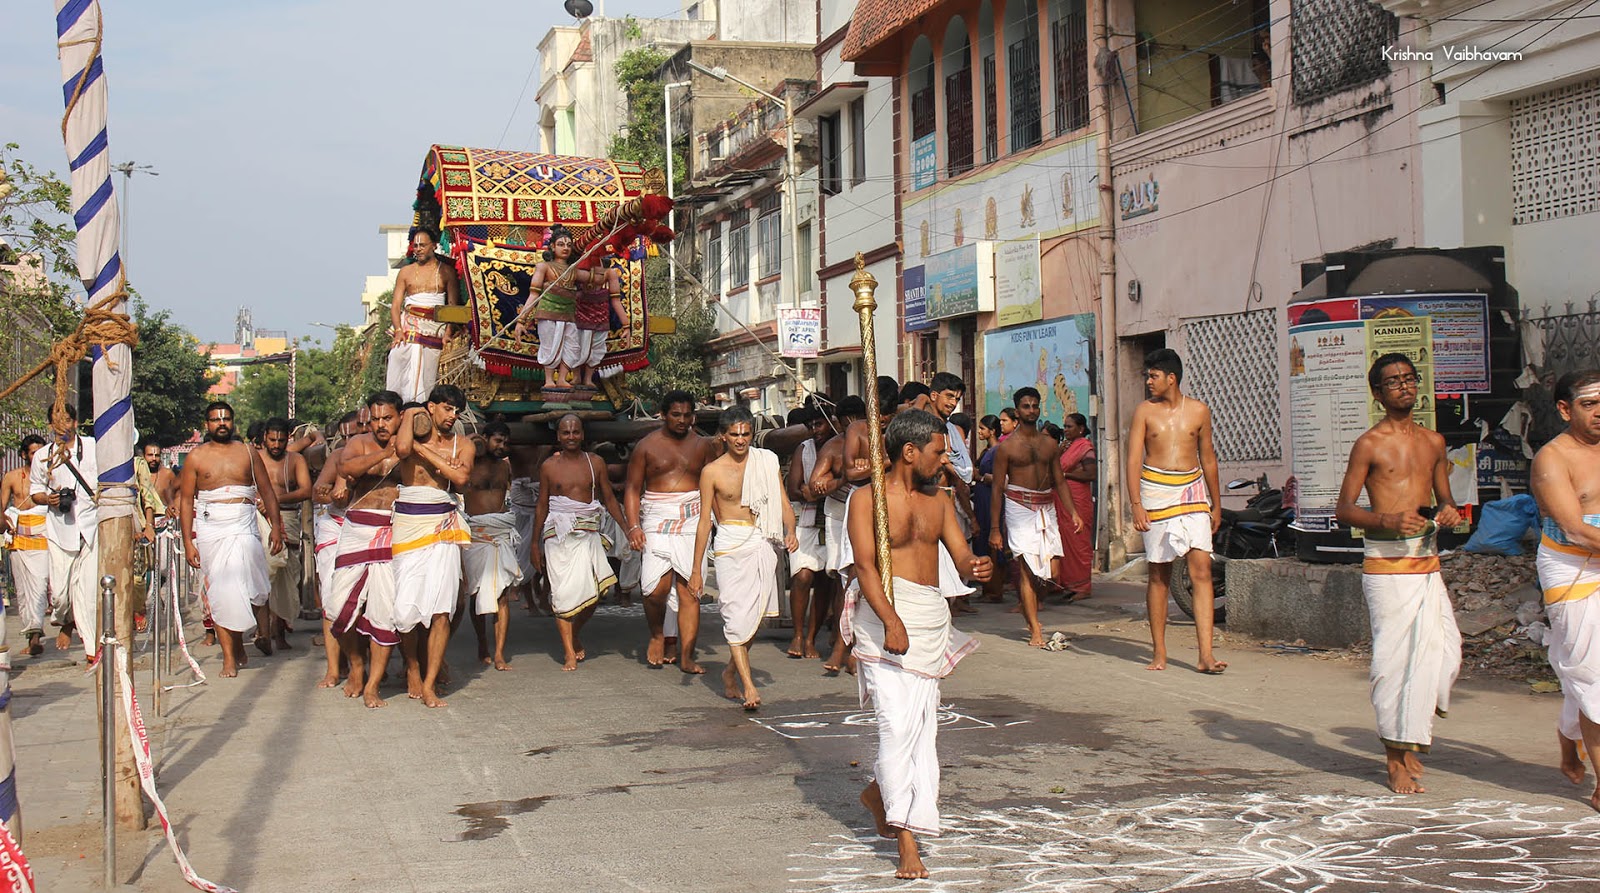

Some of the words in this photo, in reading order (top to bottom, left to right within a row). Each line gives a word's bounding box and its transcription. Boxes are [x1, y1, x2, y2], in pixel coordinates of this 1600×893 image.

[905, 287, 920, 300] SHANTI
[1010, 332, 1022, 343] KIDS
[1023, 329, 1031, 341] FUN
[1040, 326, 1057, 339] LEARN
[1374, 326, 1421, 336] KANNADA
[790, 333, 814, 346] CSC
